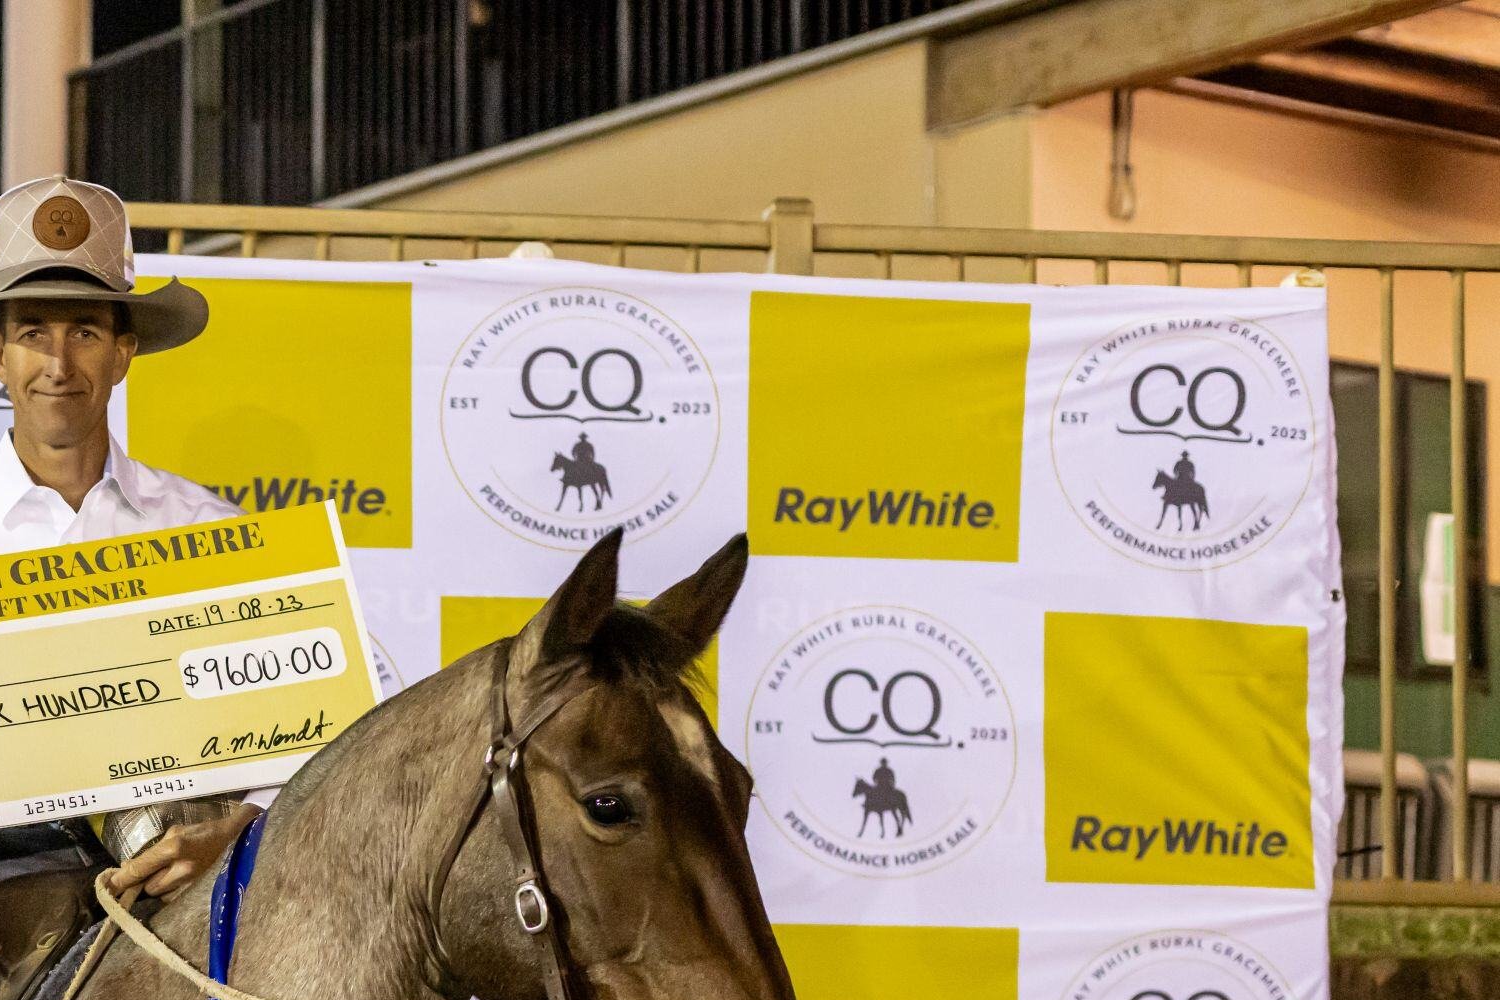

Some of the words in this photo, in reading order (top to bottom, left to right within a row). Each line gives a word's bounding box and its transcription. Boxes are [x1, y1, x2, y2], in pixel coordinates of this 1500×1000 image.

[462, 338, 488, 369] RAY
[488, 301, 542, 337] WHITE
[550, 294, 607, 309] RURAL
[615, 301, 701, 374] GRACEMERE
[1228, 322, 1301, 398] GRACEMERE
[450, 397, 479, 409] EST
[672, 402, 712, 415] 2023
[1060, 412, 1089, 424] EST
[1270, 425, 1308, 441] 2023
[479, 484, 589, 541] PERFORMANCE
[647, 490, 680, 522] SALE
[1084, 500, 1188, 560] PERFORMANCE
[1190, 539, 1239, 560] HORSE
[1240, 515, 1273, 546] SALE
[8, 521, 266, 587] GRACEMERE
[33, 578, 149, 612] WINNER
[148, 613, 201, 634] DATE:
[793, 621, 844, 657] WHITE
[851, 614, 907, 629] RURAL
[915, 621, 998, 698] GRACEMERE
[21, 677, 161, 723] HUNDRED
[754, 721, 783, 734] EST
[970, 727, 1008, 741] 2023
[107, 754, 182, 779] SIGNED:
[783, 810, 890, 868] PERFORMANCE
[894, 842, 947, 867] HORSE
[948, 817, 979, 849] SALE
